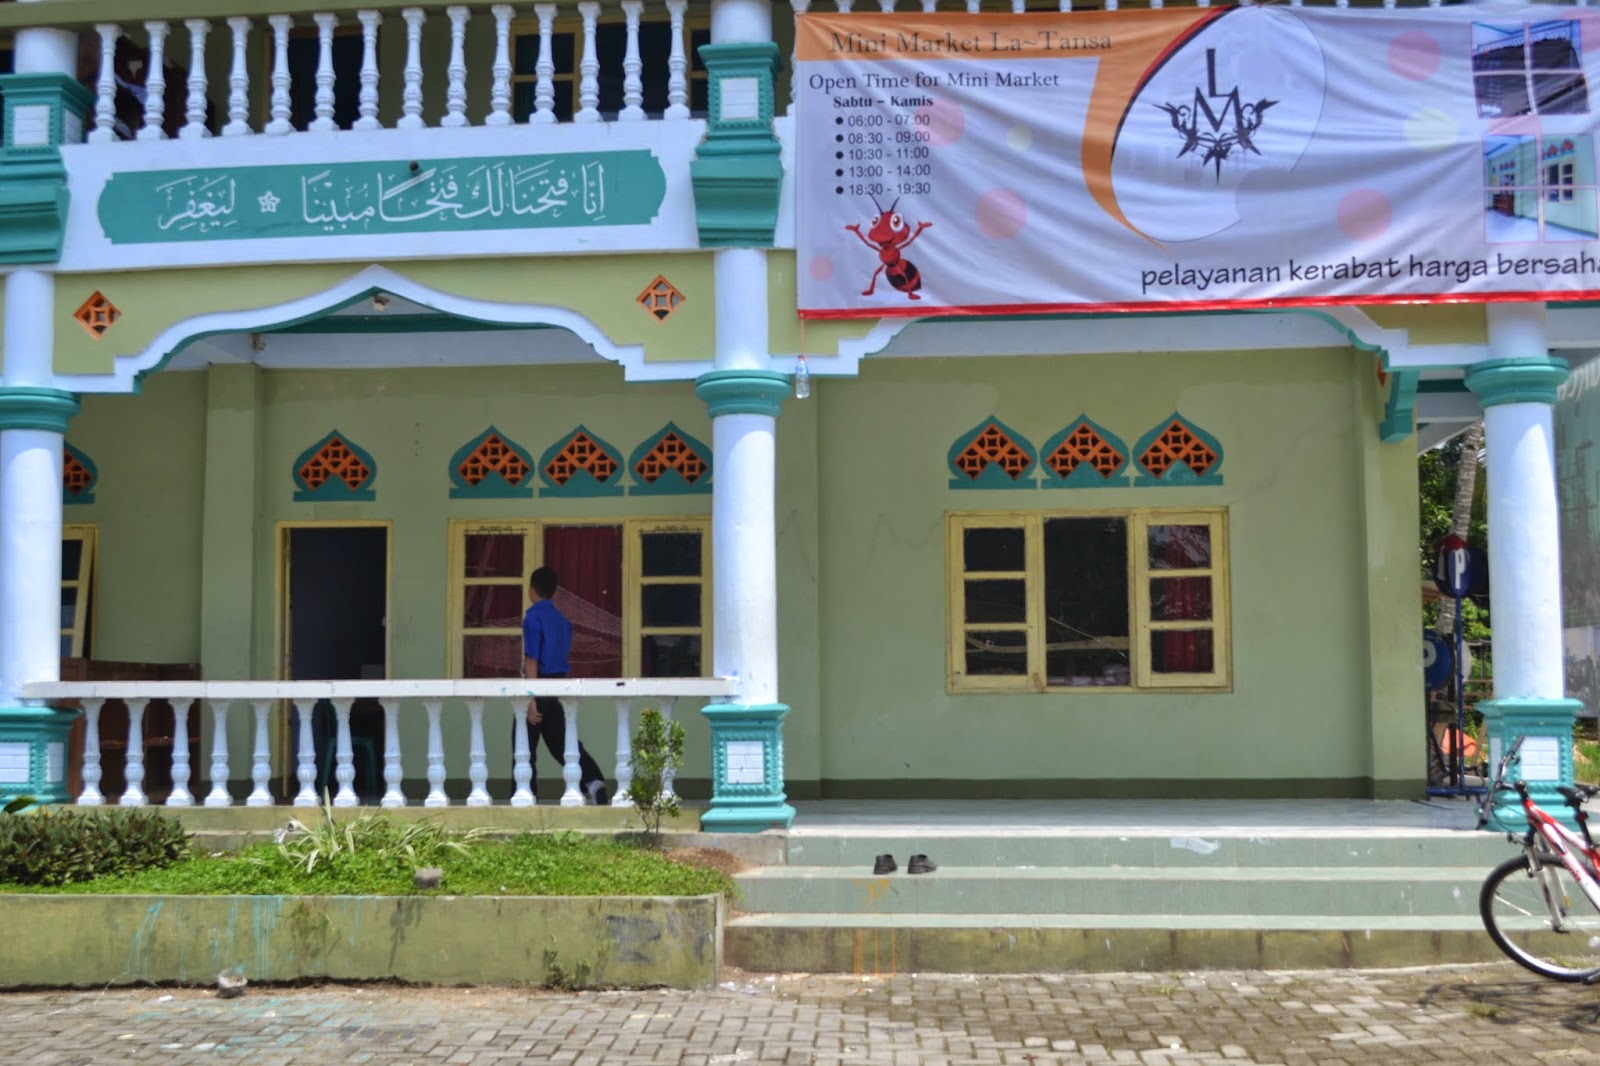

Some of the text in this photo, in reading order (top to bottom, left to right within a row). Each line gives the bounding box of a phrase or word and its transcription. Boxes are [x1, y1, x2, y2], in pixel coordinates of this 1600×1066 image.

[830, 33, 887, 54] Mini
[895, 30, 982, 54] Market
[809, 72, 1059, 94] Open Time for Mini Market
[833, 96, 873, 108] Sabtu
[890, 95, 933, 107] Kamis
[847, 115, 882, 128] 06:00
[895, 114, 931, 127] 07:00
[847, 131, 882, 144] 08:30
[895, 130, 931, 143] 09:00
[848, 147, 882, 160] 10:30
[896, 146, 930, 159] 11:00
[849, 164, 884, 177] 13:00
[896, 163, 932, 176] 14:00
[849, 182, 884, 195] 18:30
[896, 181, 932, 194] 19:30
[1141, 250, 1600, 294] pelayanan kerabat harga bersah
[1454, 549, 1466, 590] P
